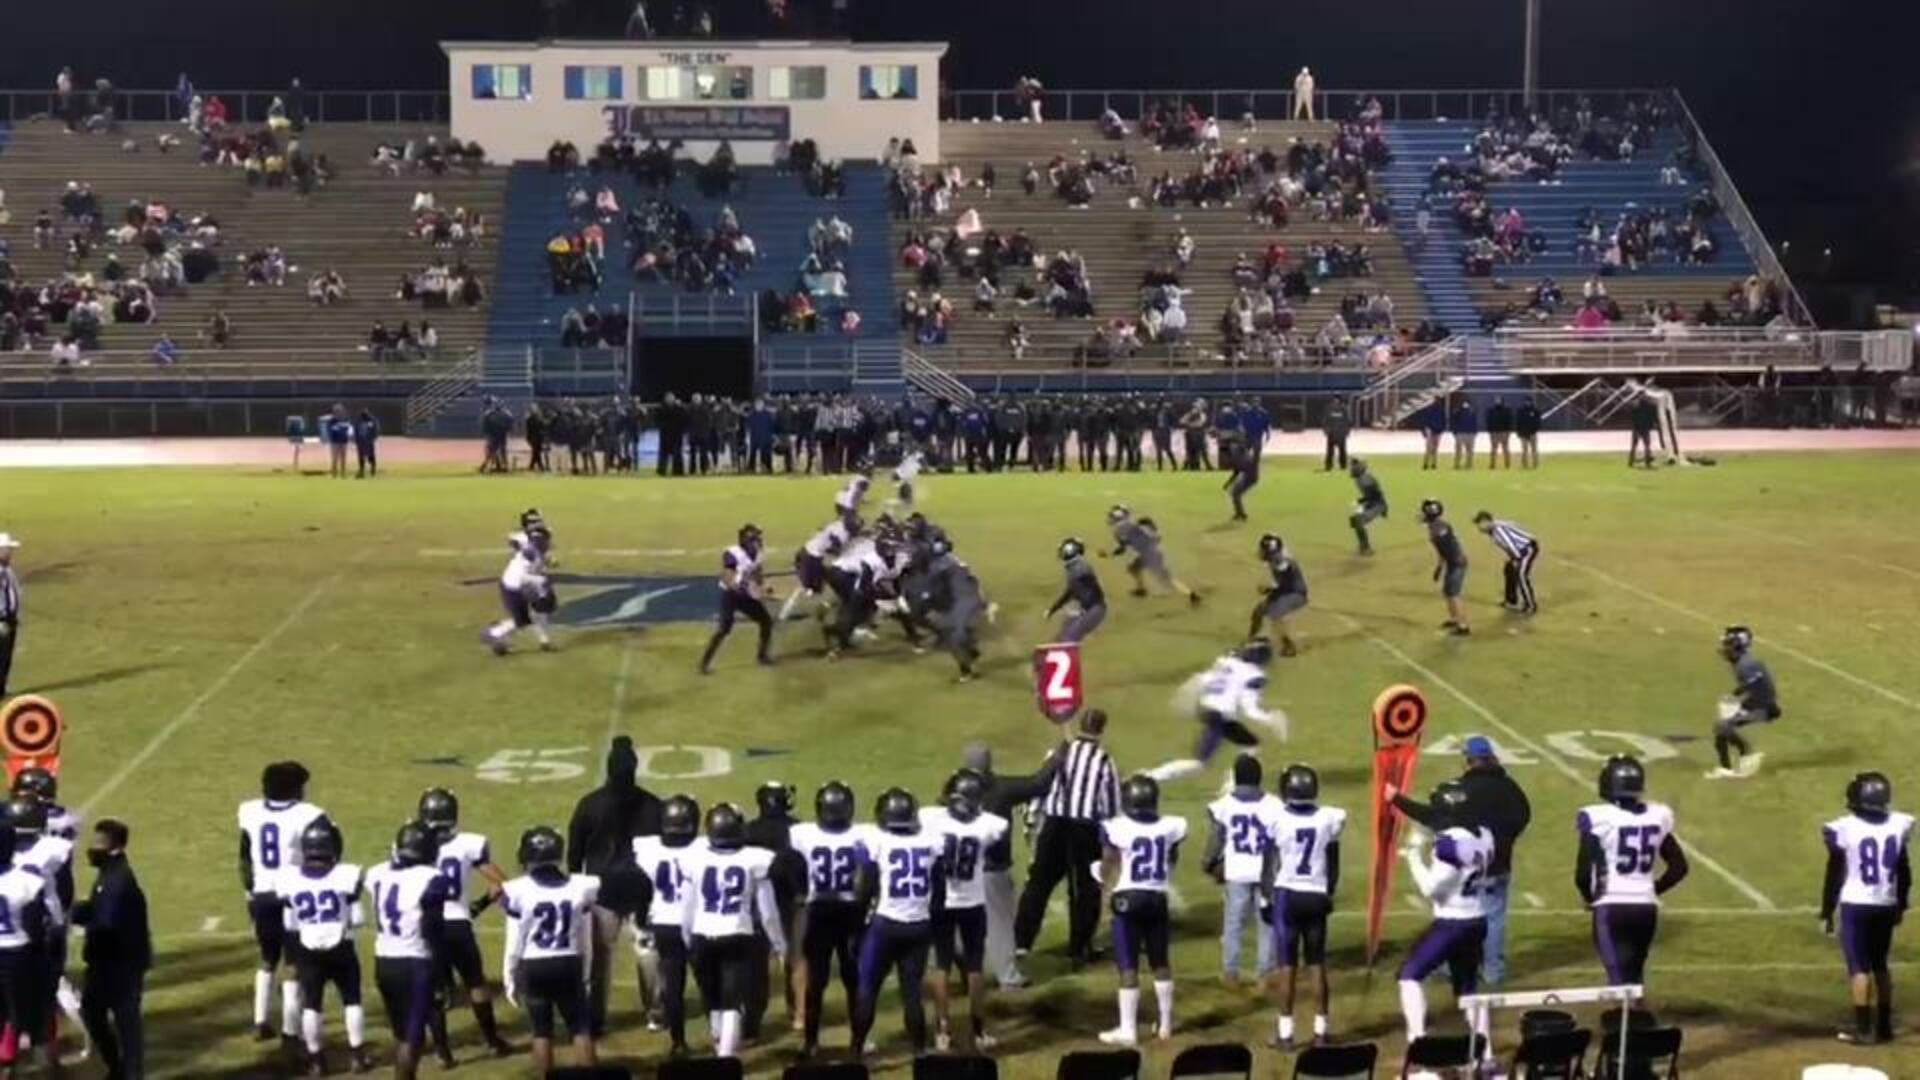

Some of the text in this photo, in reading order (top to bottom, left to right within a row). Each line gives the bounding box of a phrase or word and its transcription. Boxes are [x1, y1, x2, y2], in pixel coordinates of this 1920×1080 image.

[1045, 650, 1074, 700] 2
[475, 745, 733, 783] 50
[259, 823, 280, 869] 8
[1130, 836, 1168, 883] 21
[1296, 827, 1317, 876] 7
[1615, 825, 1661, 875] 55
[656, 859, 684, 903] 4
[701, 866, 746, 915] 42
[811, 847, 854, 893] 32
[888, 848, 933, 899] 25
[295, 889, 341, 924] 22
